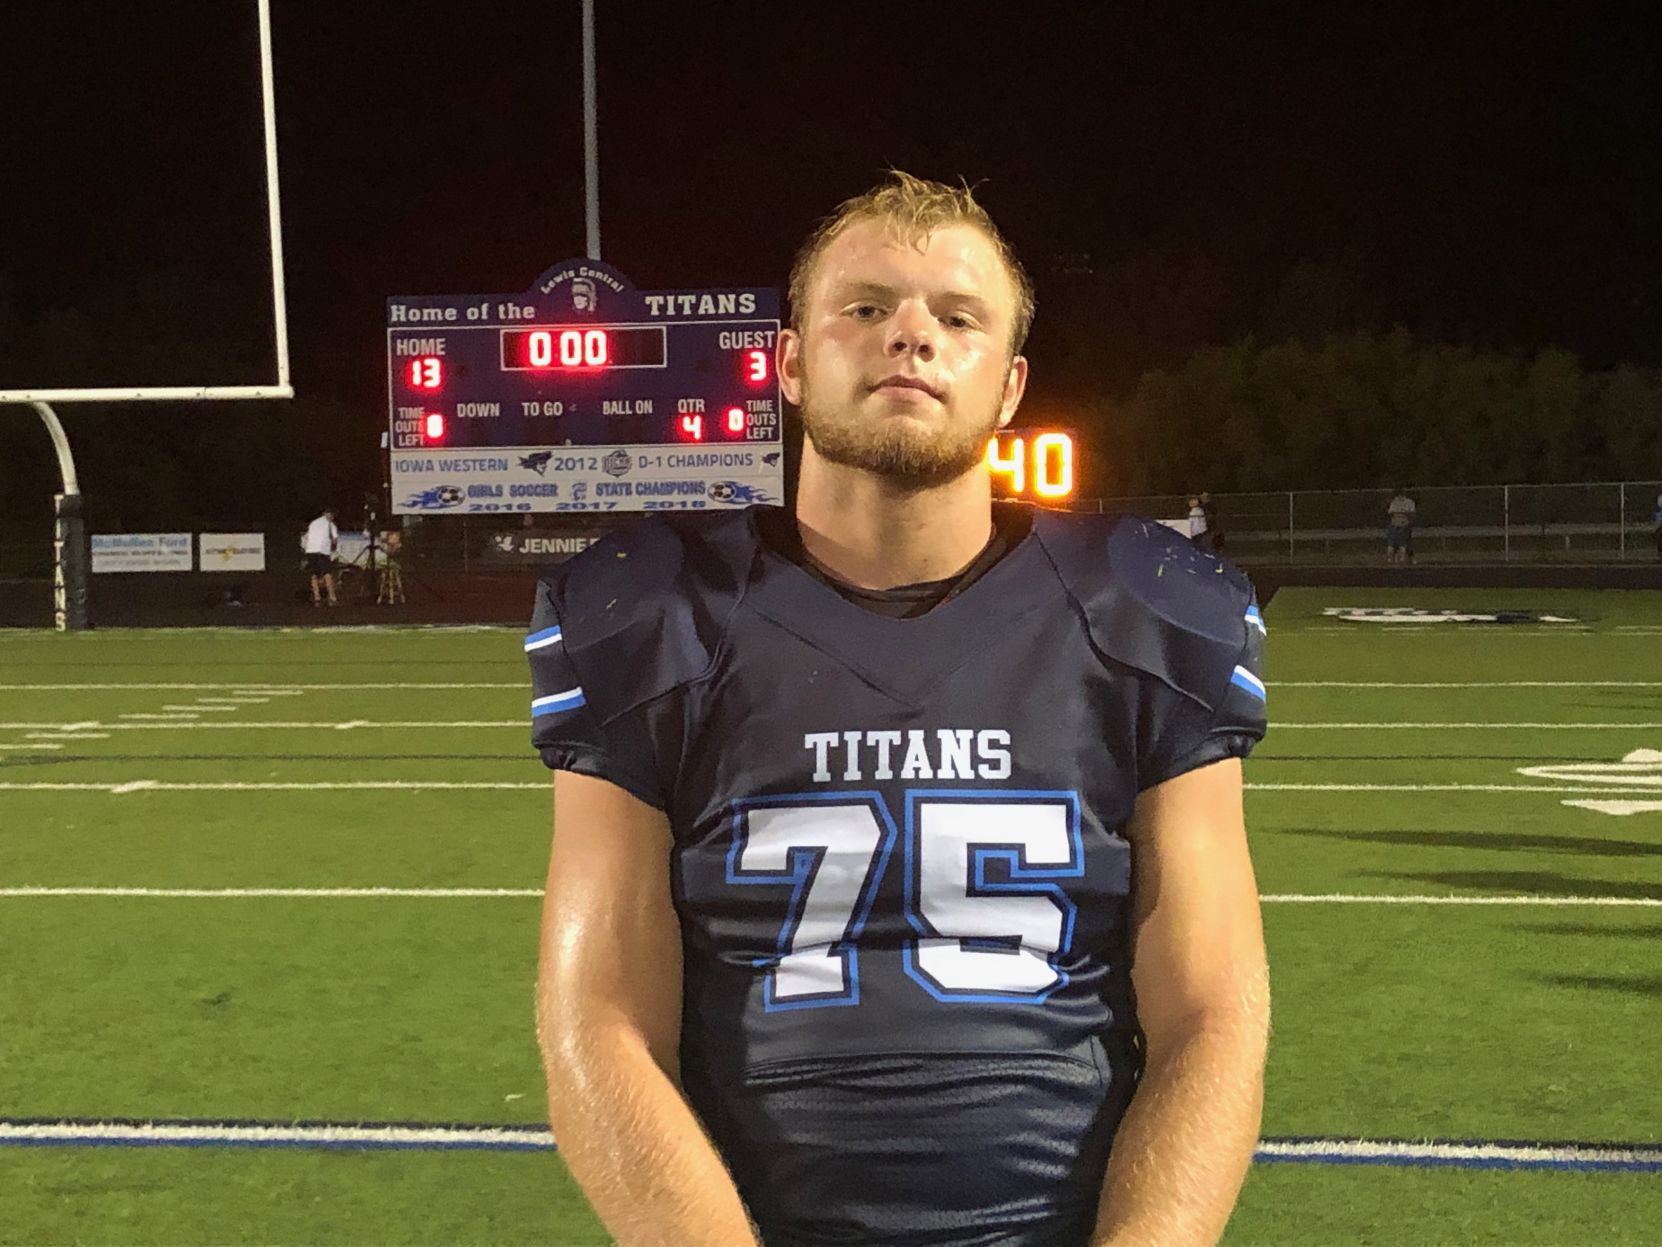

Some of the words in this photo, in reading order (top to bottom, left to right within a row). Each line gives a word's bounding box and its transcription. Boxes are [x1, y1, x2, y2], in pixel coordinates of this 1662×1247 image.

[540, 270, 575, 294] Lewis
[580, 266, 624, 292] Central
[390, 304, 457, 322] Home
[466, 303, 489, 320] of
[498, 302, 536, 319] the
[645, 293, 756, 316] TITANS
[396, 337, 447, 356] HOME
[718, 330, 776, 350] GUEST
[412, 358, 442, 388] 13
[750, 352, 767, 381] 3
[398, 407, 425, 419] TIME
[456, 402, 500, 418] DOWN
[522, 402, 540, 416] TO
[544, 402, 564, 416] GO
[602, 401, 632, 415] BALL
[636, 400, 653, 414] ON
[678, 398, 705, 414] QTR
[746, 400, 773, 412] TIME
[682, 416, 702, 440] 4
[728, 408, 744, 432] 0
[746, 413, 777, 426] OUTS
[398, 434, 425, 446] LEFT
[746, 427, 773, 440] LEFT
[396, 459, 434, 472] IOWA
[438, 458, 508, 472] WESTERN
[554, 456, 598, 471] 2012
[638, 455, 662, 468] D-1
[668, 453, 754, 468] CHAMPIONS
[988, 432, 1072, 496] 40
[468, 484, 504, 498] GIRLS
[510, 483, 558, 497] SOCCER
[596, 482, 632, 496] STATE
[636, 480, 706, 496] CHAMPIONS
[556, 501, 618, 510] 2017
[519, 538, 587, 553] JENNIE
[804, 729, 1012, 782] TITANS
[726, 789, 1085, 1012] 75
